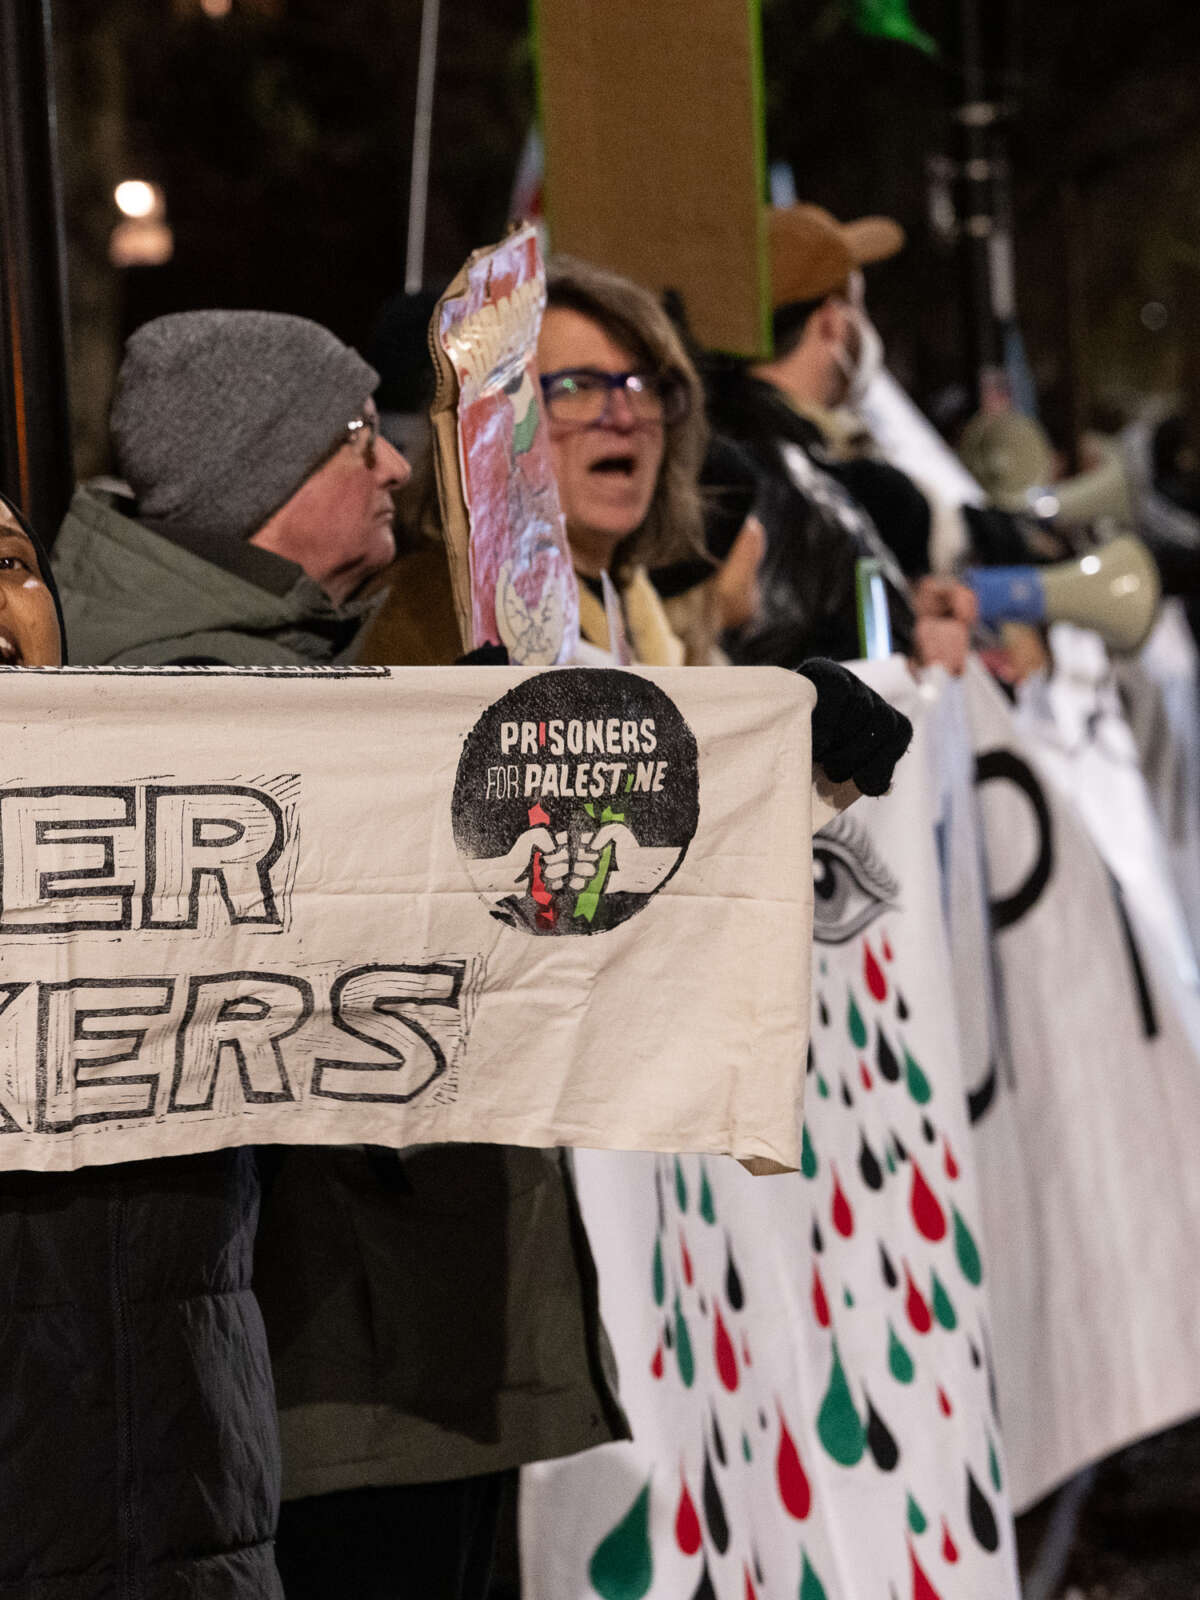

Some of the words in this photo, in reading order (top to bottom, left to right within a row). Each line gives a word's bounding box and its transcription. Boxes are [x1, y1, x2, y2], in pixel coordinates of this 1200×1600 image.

[500, 718, 658, 756] PRISONERS
[485, 765, 519, 800] FOR
[523, 760, 668, 798] PALESTINE
